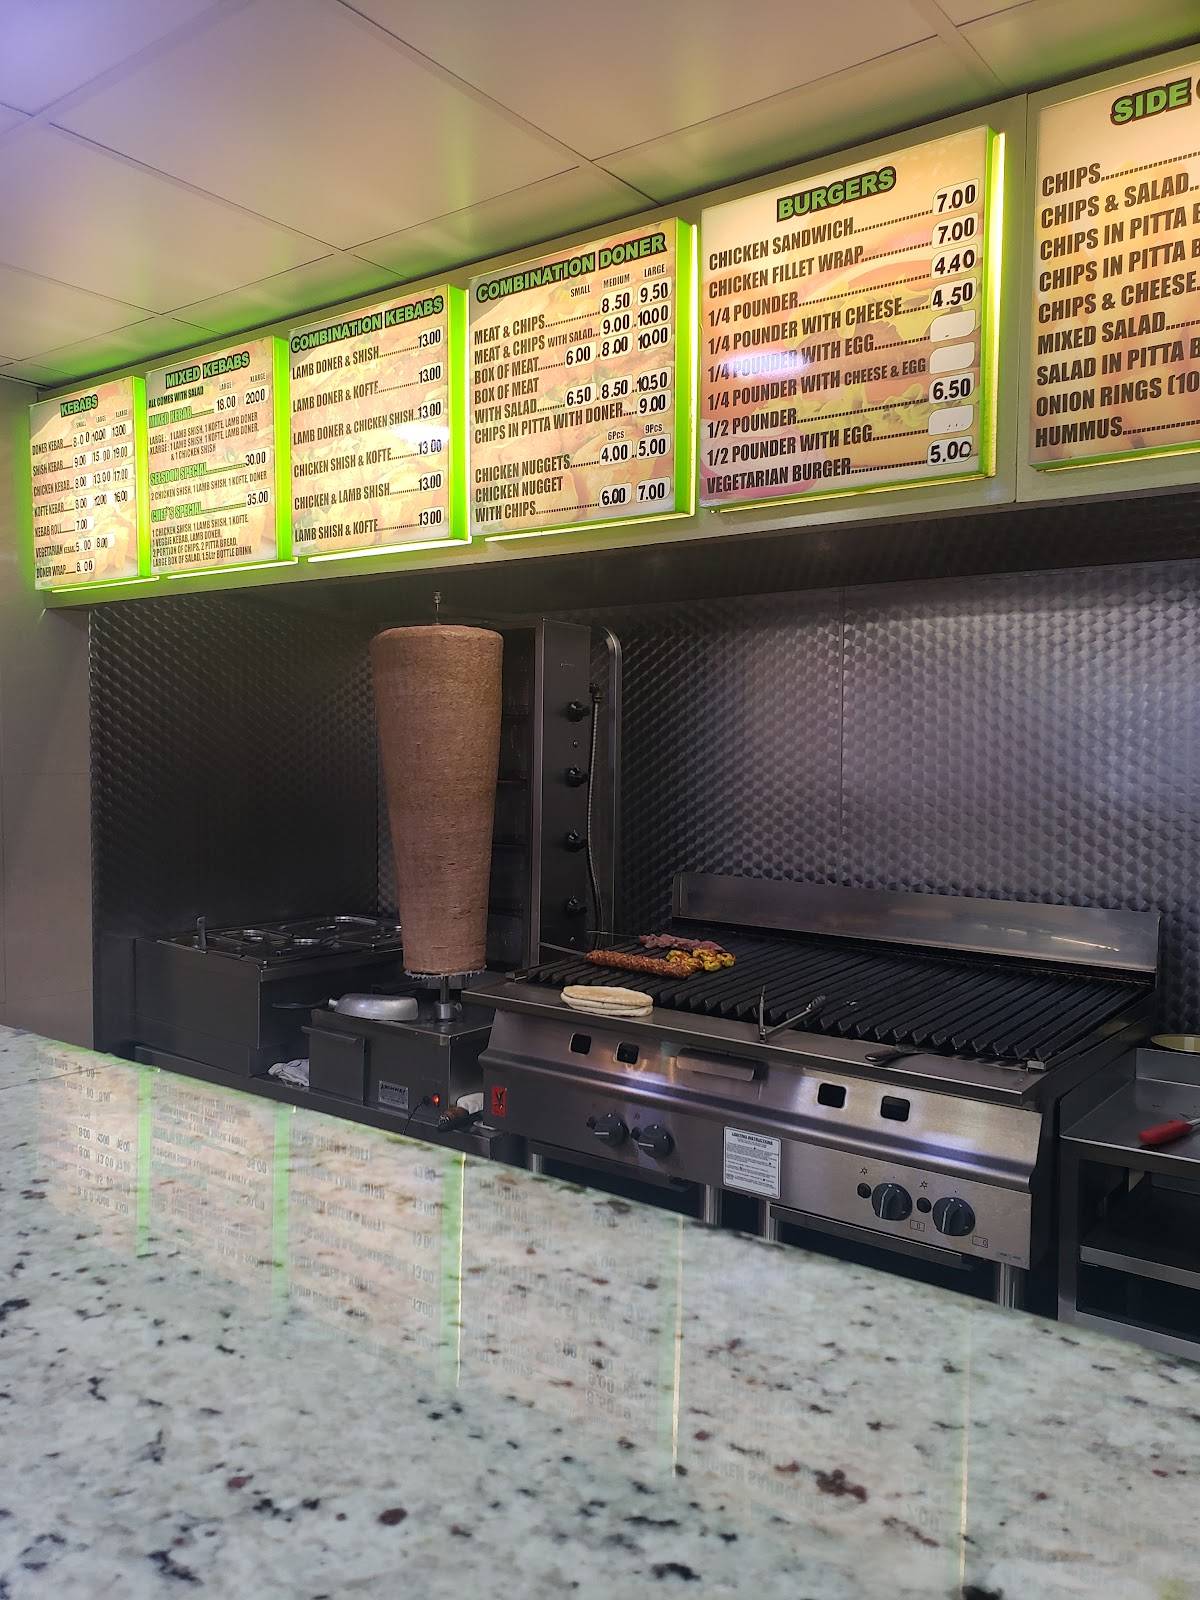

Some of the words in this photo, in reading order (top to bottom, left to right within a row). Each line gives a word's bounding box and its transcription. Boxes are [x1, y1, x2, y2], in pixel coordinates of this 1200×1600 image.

[1110, 77, 1192, 126] SIDE
[777, 166, 897, 222] BURGERS
[1041, 195, 1100, 229] CHIPS
[1104, 194, 1119, 213] &
[1124, 172, 1189, 208] SALAD
[1042, 162, 1101, 197] CHIPS
[709, 239, 769, 271] CHICKEN
[772, 216, 854, 255] SANDWICH
[937, 184, 976, 213] 7.00
[1040, 228, 1099, 261] CHIPS
[1104, 221, 1124, 246] IN
[1130, 206, 1187, 239] PITTA
[477, 251, 595, 303] COMBINATION
[599, 232, 667, 270] DONER
[570, 284, 591, 298] SMALL
[603, 273, 630, 289] MEDIUM
[644, 264, 665, 278] LARGE
[709, 269, 769, 299] CHICKEN
[772, 257, 815, 284] FILLET
[818, 245, 864, 272] WRAP
[938, 217, 975, 245] 7.00
[1039, 260, 1098, 293] CHIPS
[1103, 254, 1123, 279] IN
[1129, 240, 1186, 273] PITTA
[708, 306, 730, 327] 1/4
[733, 291, 799, 322] POUNDER
[934, 249, 975, 275] 4.40
[1038, 293, 1097, 324] CHIPS
[1101, 292, 1116, 311] &
[1121, 270, 1197, 307] CHEESE
[291, 312, 382, 353] COMBINATION
[385, 295, 443, 328] KEBABS
[474, 325, 500, 345] MEAT
[503, 325, 510, 339] &
[513, 314, 545, 336] CHIPS
[602, 292, 630, 313] 8.50
[640, 282, 668, 303] 9.50
[708, 334, 730, 355] 1/4
[733, 320, 798, 350] POUNDER
[802, 310, 842, 336] WITH
[845, 296, 902, 326] CHEESE
[933, 282, 973, 308] 4.50
[1037, 325, 1097, 355] MIXED
[1101, 311, 1166, 343] SALAD
[292, 362, 314, 380] LAMB
[316, 355, 343, 374] DONER
[345, 355, 350, 367] &
[352, 346, 379, 366] SHISH
[418, 329, 440, 348] 13.00
[474, 345, 500, 365] MEAT
[503, 345, 510, 359] &
[513, 334, 545, 357] CHIPS
[548, 334, 568, 348] WITH
[569, 328, 593, 343] SALAD
[603, 314, 630, 335] 9.00
[474, 367, 495, 385] BOX
[497, 363, 510, 379] OF
[512, 357, 539, 377] MEAT
[566, 345, 591, 365] 6.00
[602, 336, 628, 356] 8.00
[1037, 357, 1097, 386] SALAD
[1101, 352, 1122, 375] IN
[1128, 340, 1185, 370] PITTA
[166, 365, 201, 389] MIXED
[203, 350, 250, 379] KEBABS
[293, 396, 314, 413] LAMB
[316, 389, 343, 407] DONER
[345, 389, 351, 400] &
[353, 380, 379, 400] KOFTE
[418, 365, 441, 383] 13.00
[707, 390, 730, 411] 1/4
[732, 378, 797, 406] POUNDER
[801, 369, 840, 394] WITH
[844, 364, 888, 386] CHEESE
[890, 365, 899, 378] &
[902, 357, 926, 375] EGG
[60, 394, 98, 417] KEBABS
[157, 394, 173, 407] COMES
[174, 390, 187, 401] WITH
[188, 385, 204, 399] SALAD
[474, 424, 505, 444] CHIPS
[508, 422, 519, 438] IN
[521, 416, 551, 436] PITTA
[553, 409, 583, 430] WITH
[585, 402, 623, 424] DONER
[640, 394, 666, 414] 9.00
[475, 406, 501, 424] WITH
[504, 399, 537, 418] SALAD
[566, 386, 591, 406] 6.50
[602, 379, 628, 399] 8.50
[707, 419, 729, 439] 1/2
[732, 407, 797, 435] POUNDER
[932, 377, 971, 400] 6.50
[1036, 388, 1095, 417] ONION
[1100, 377, 1162, 407] RINGS
[48, 439, 63, 451] KEBAB
[293, 429, 315, 446] LAMB
[317, 423, 344, 440] DONER
[346, 423, 352, 435] &
[354, 415, 387, 434] CHICKEN
[389, 409, 414, 426] SHISH
[418, 401, 441, 420] 13.00
[707, 447, 728, 467] 1/2
[731, 436, 796, 463] POUNDER
[800, 429, 839, 453] WITH
[843, 423, 873, 445] EGG
[1035, 416, 1123, 448] HUMMUS
[180, 462, 207, 480] SPECIAL
[475, 462, 519, 484] CHICKEN
[522, 454, 570, 477] NUGGETS
[602, 444, 628, 462] 4.00
[638, 438, 666, 457] 5.00
[706, 466, 789, 494] VEGETARIAN
[792, 457, 851, 482] BURGER
[930, 440, 972, 464] 5.00
[247, 490, 268, 506] 35.00
[294, 493, 329, 511] CHICKEN
[330, 493, 337, 505] &
[339, 487, 362, 503] LAMB
[364, 482, 390, 500] SHISH
[418, 473, 441, 491] 13.00
[475, 505, 502, 522] WITH
[504, 500, 536, 519] CHIPS
[602, 487, 626, 505] 6.00
[638, 482, 665, 500] 7.00
